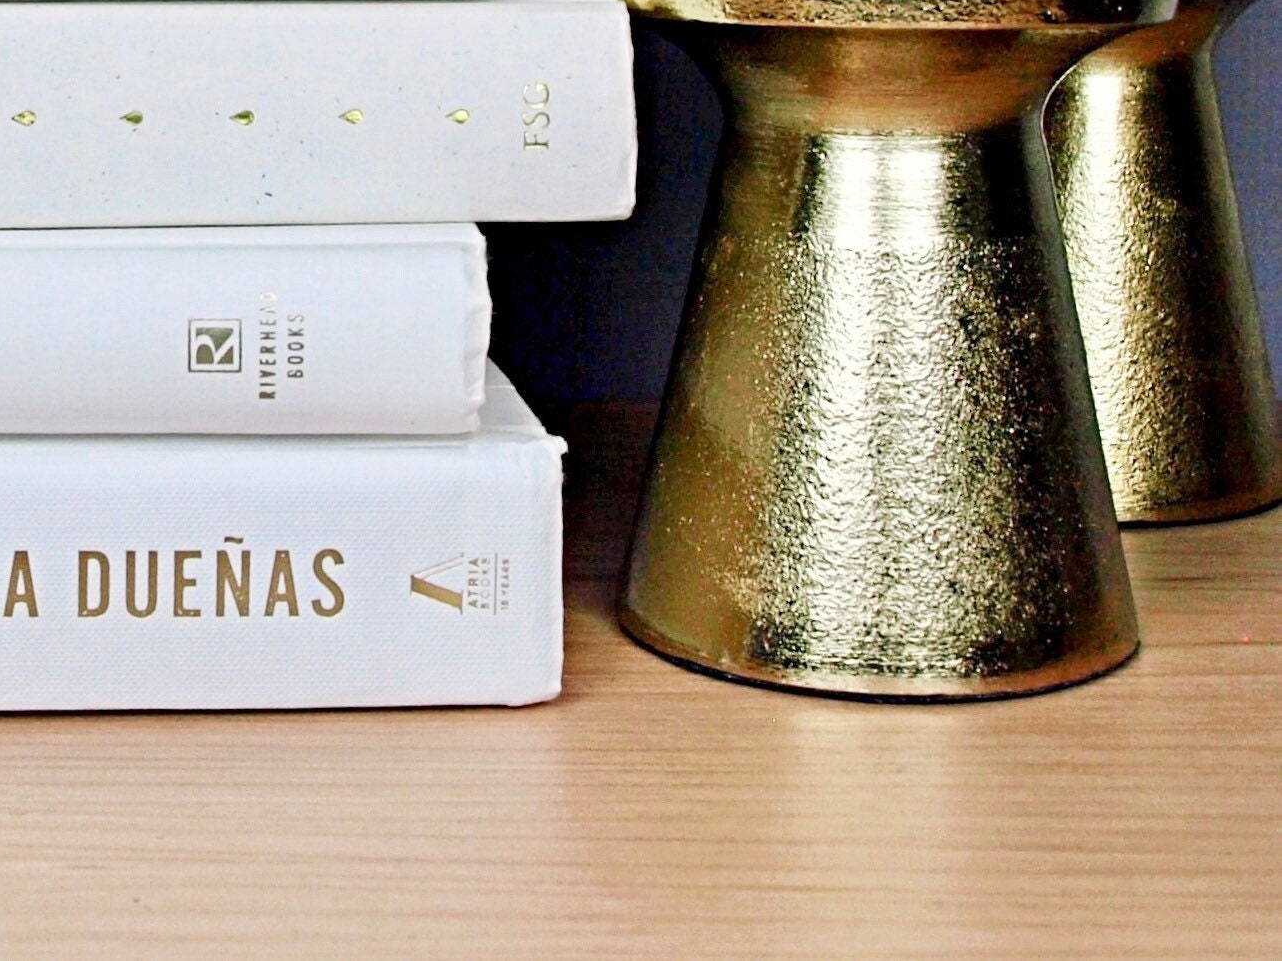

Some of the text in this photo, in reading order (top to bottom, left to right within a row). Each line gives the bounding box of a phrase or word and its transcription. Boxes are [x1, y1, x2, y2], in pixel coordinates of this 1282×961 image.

[522, 82, 550, 151] FSG
[258, 291, 277, 400] RIVERHEAD
[287, 314, 305, 379] BOOKS
[77, 537, 346, 619] DUEÑAS
[467, 557, 480, 609] ATRIA
[479, 558, 491, 610] BOOKS
